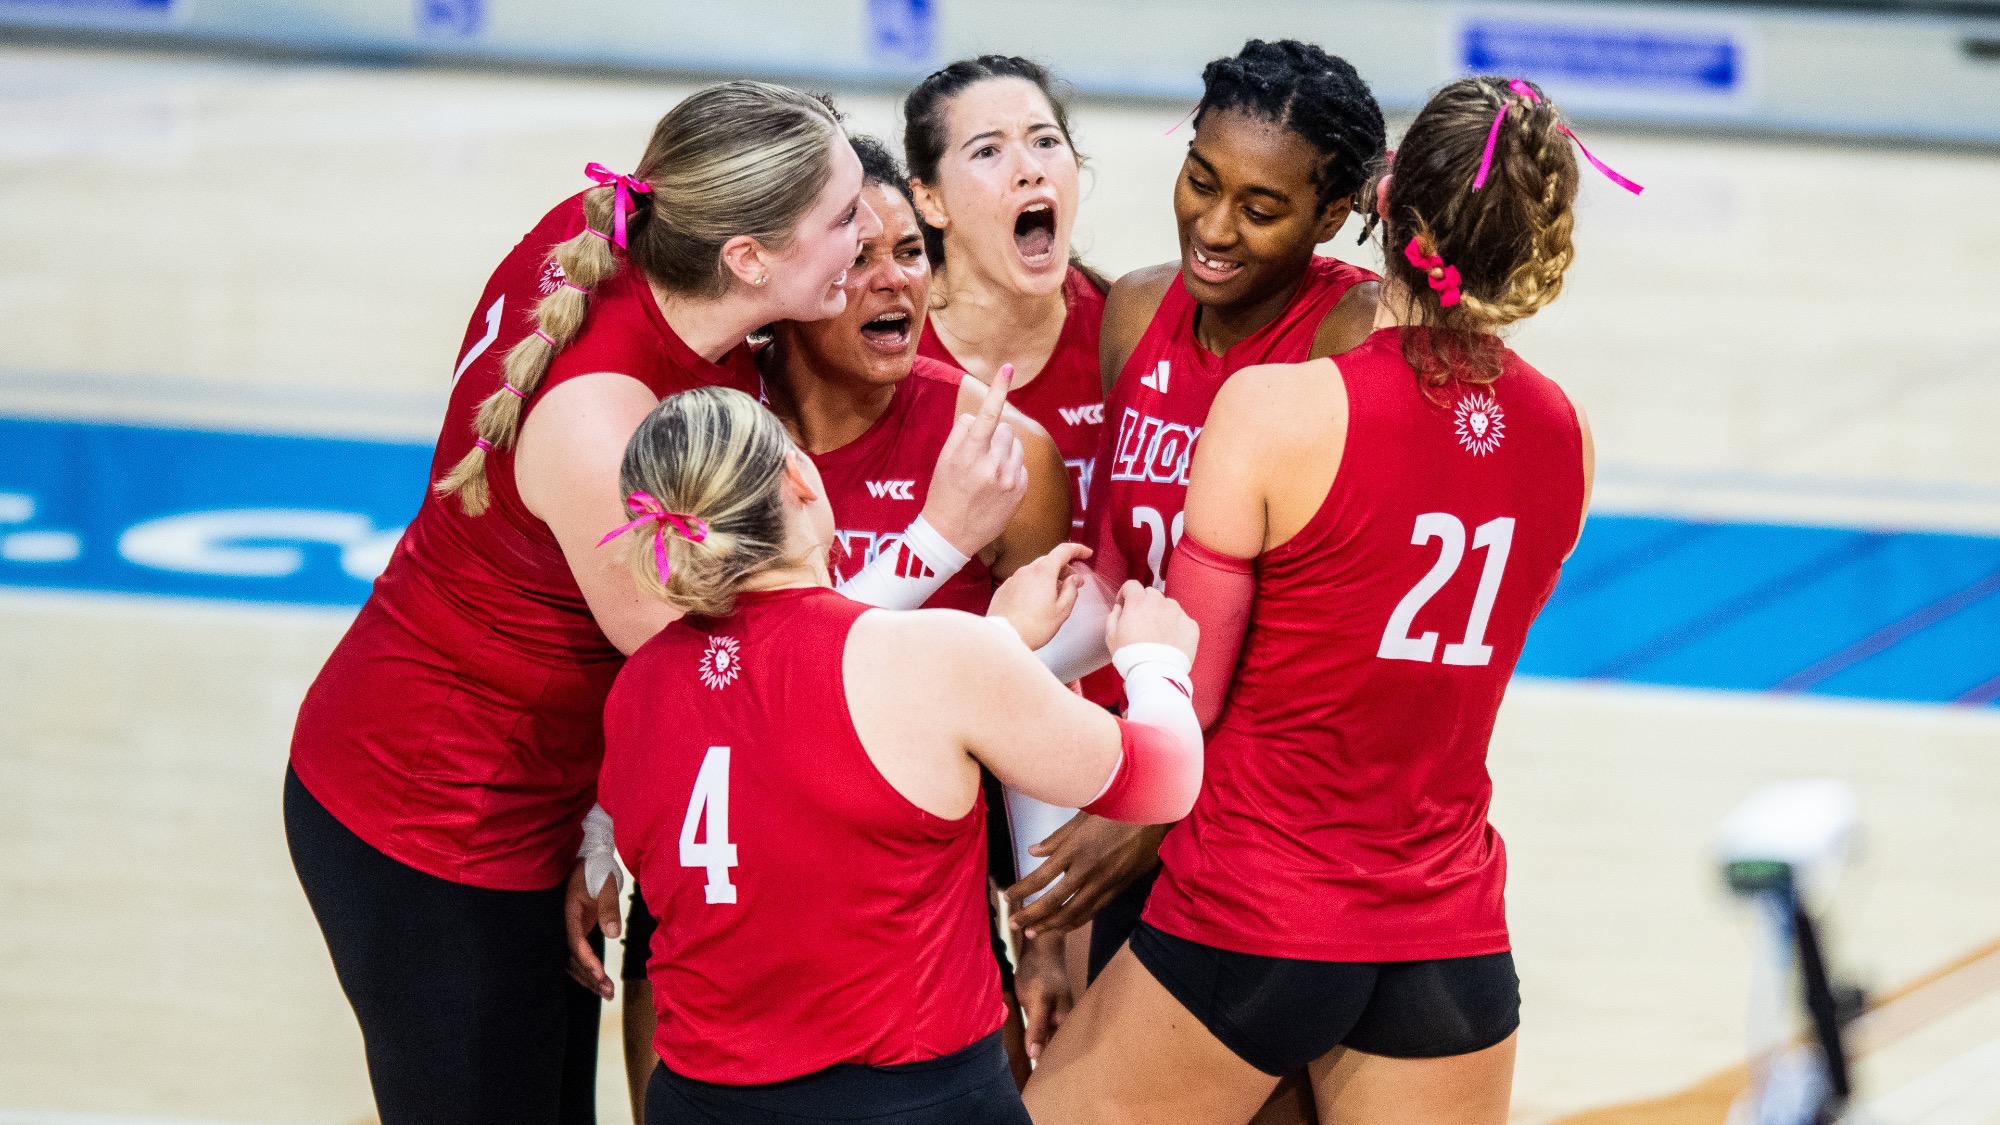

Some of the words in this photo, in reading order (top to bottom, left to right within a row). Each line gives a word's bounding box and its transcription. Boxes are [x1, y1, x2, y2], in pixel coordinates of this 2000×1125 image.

[1058, 403, 1104, 427] WCC
[865, 480, 916, 500] WCC
[1376, 512, 1516, 666] 21
[678, 745, 738, 905] 4
